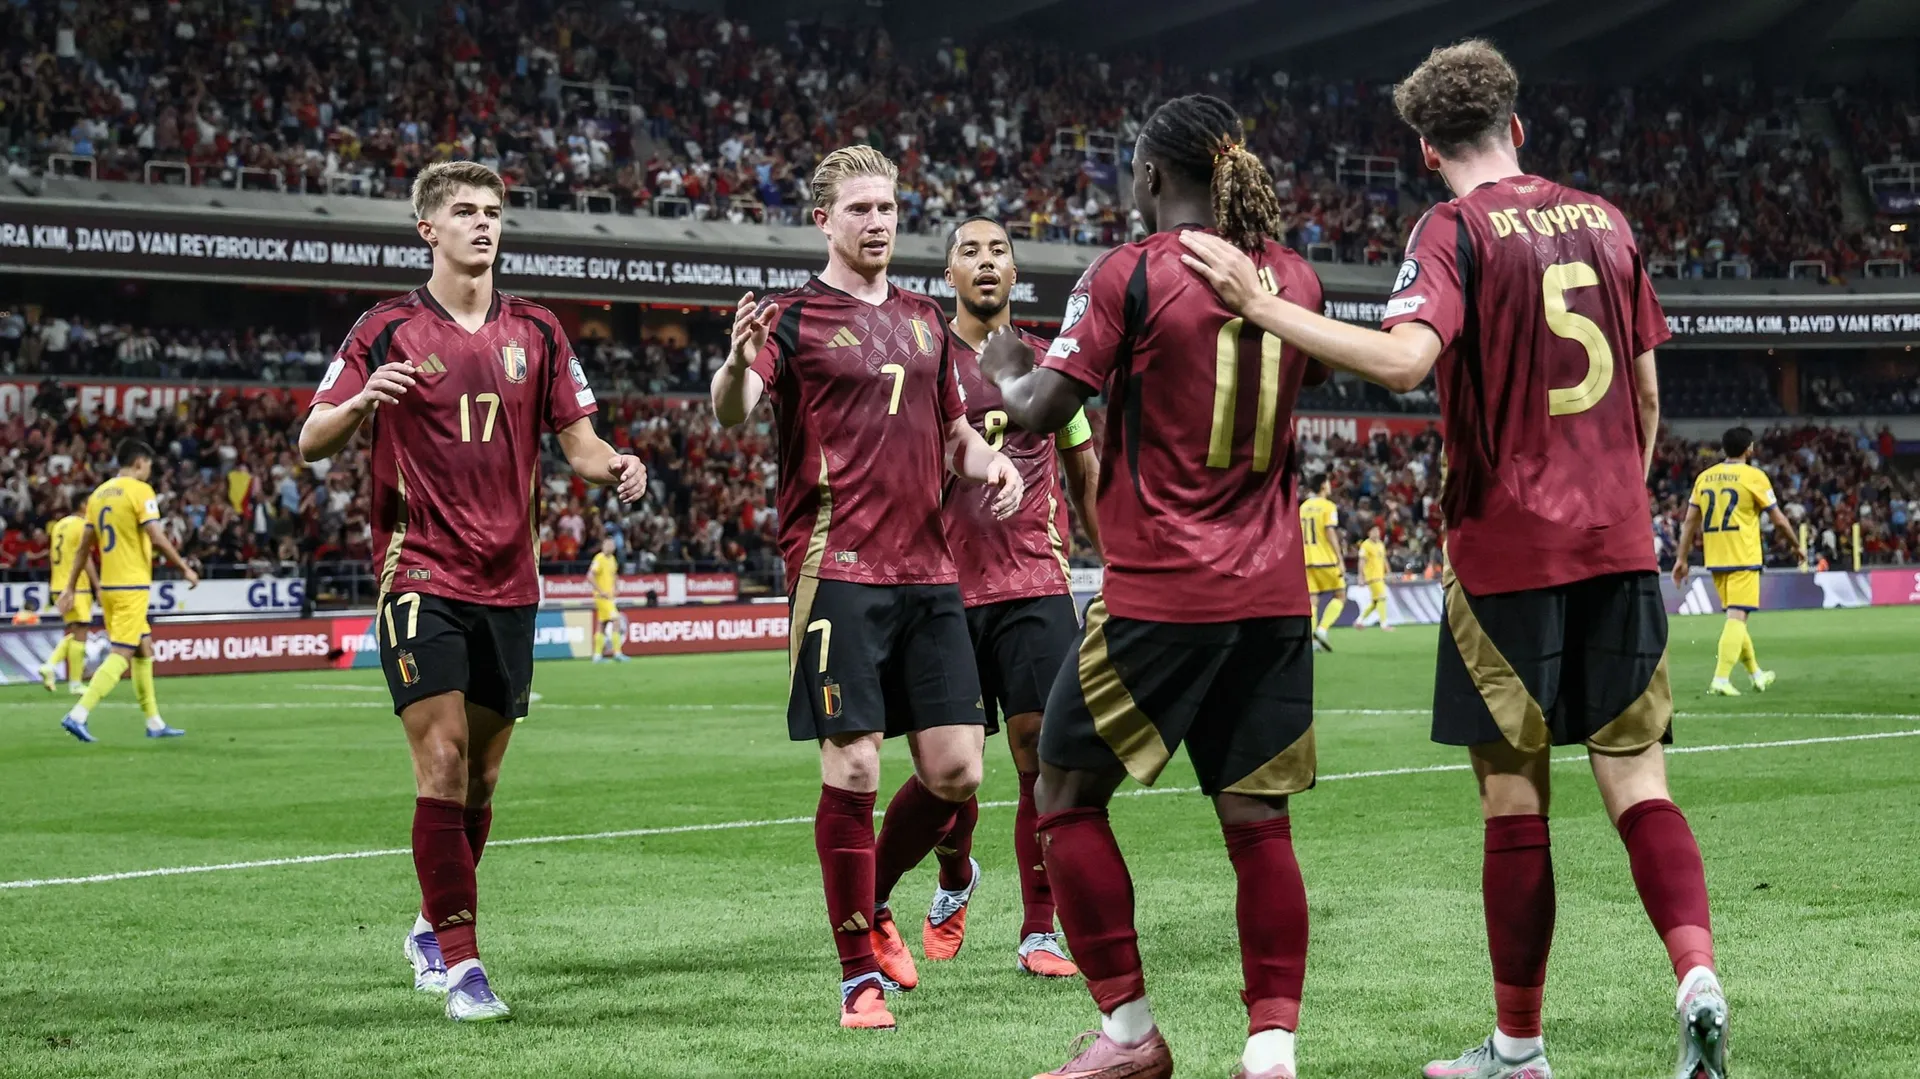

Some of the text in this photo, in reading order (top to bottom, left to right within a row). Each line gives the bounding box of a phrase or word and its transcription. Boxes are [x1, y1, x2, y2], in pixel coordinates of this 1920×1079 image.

[1488, 203, 1614, 239] DE CUYPER
[0, 223, 29, 247] RA
[32, 225, 73, 253] KIM,
[75, 227, 135, 253] DAVID
[137, 230, 176, 255] VAN
[179, 233, 288, 262] REYBROUCK
[291, 240, 328, 264] AND
[331, 242, 380, 267] MANY
[500, 252, 587, 279] ZWANGERE
[587, 257, 624, 283] GUY,
[626, 259, 669, 286] COLT,
[671, 262, 734, 287] SANDRA
[735, 265, 765, 290] KIM,
[1333, 301, 1358, 321] VAN
[1696, 315, 1754, 334] SANDRA
[1757, 315, 1786, 336] KIM,
[1788, 315, 1836, 334] DAVID
[1838, 314, 1869, 333] VAN
[1872, 313, 1920, 332] REYBR
[1542, 261, 1614, 416] 5
[880, 363, 906, 415] 7
[1206, 317, 1282, 473] 11
[459, 392, 501, 443] 17
[984, 410, 1009, 452] 8
[98, 506, 117, 554] 6
[1700, 487, 1740, 533] 22
[53, 534, 64, 565] 3
[0, 585, 40, 613] LS
[247, 581, 304, 608] GLS
[384, 592, 421, 649] 17
[629, 616, 789, 643] EUROPEAN QUALIFIER
[152, 633, 330, 662] OPEAN QUALIFIERS
[341, 633, 378, 653] FIFA
[807, 618, 832, 674] 7
